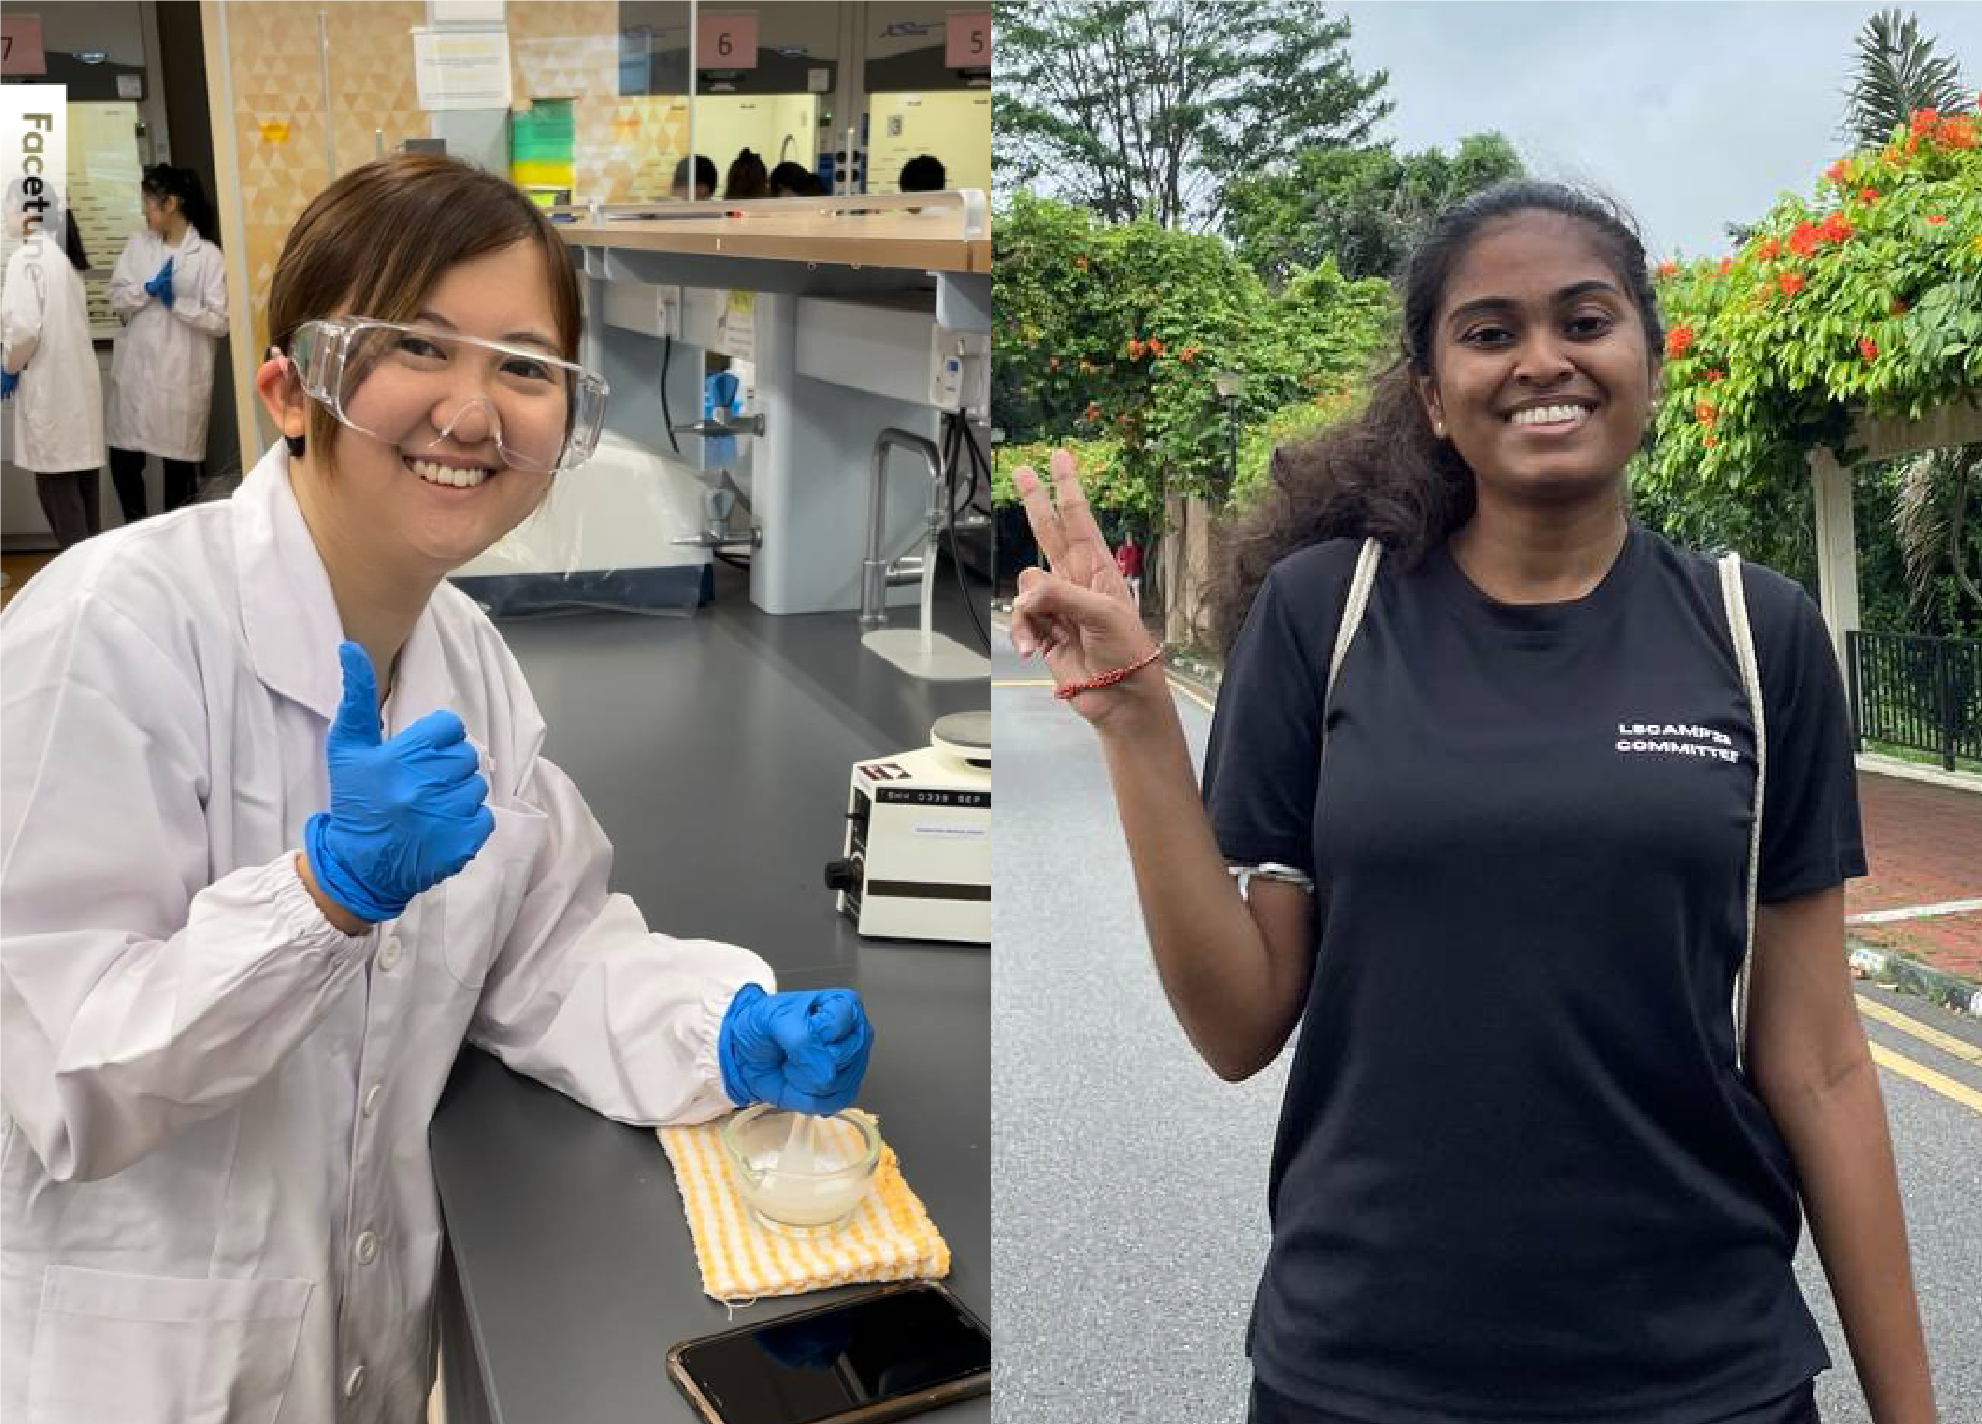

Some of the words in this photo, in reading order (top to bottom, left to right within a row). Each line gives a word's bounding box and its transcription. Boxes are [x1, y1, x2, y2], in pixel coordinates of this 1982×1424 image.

[1, 37, 12, 61] 7
[718, 32, 733, 55] 6
[970, 30, 983, 54] 5
